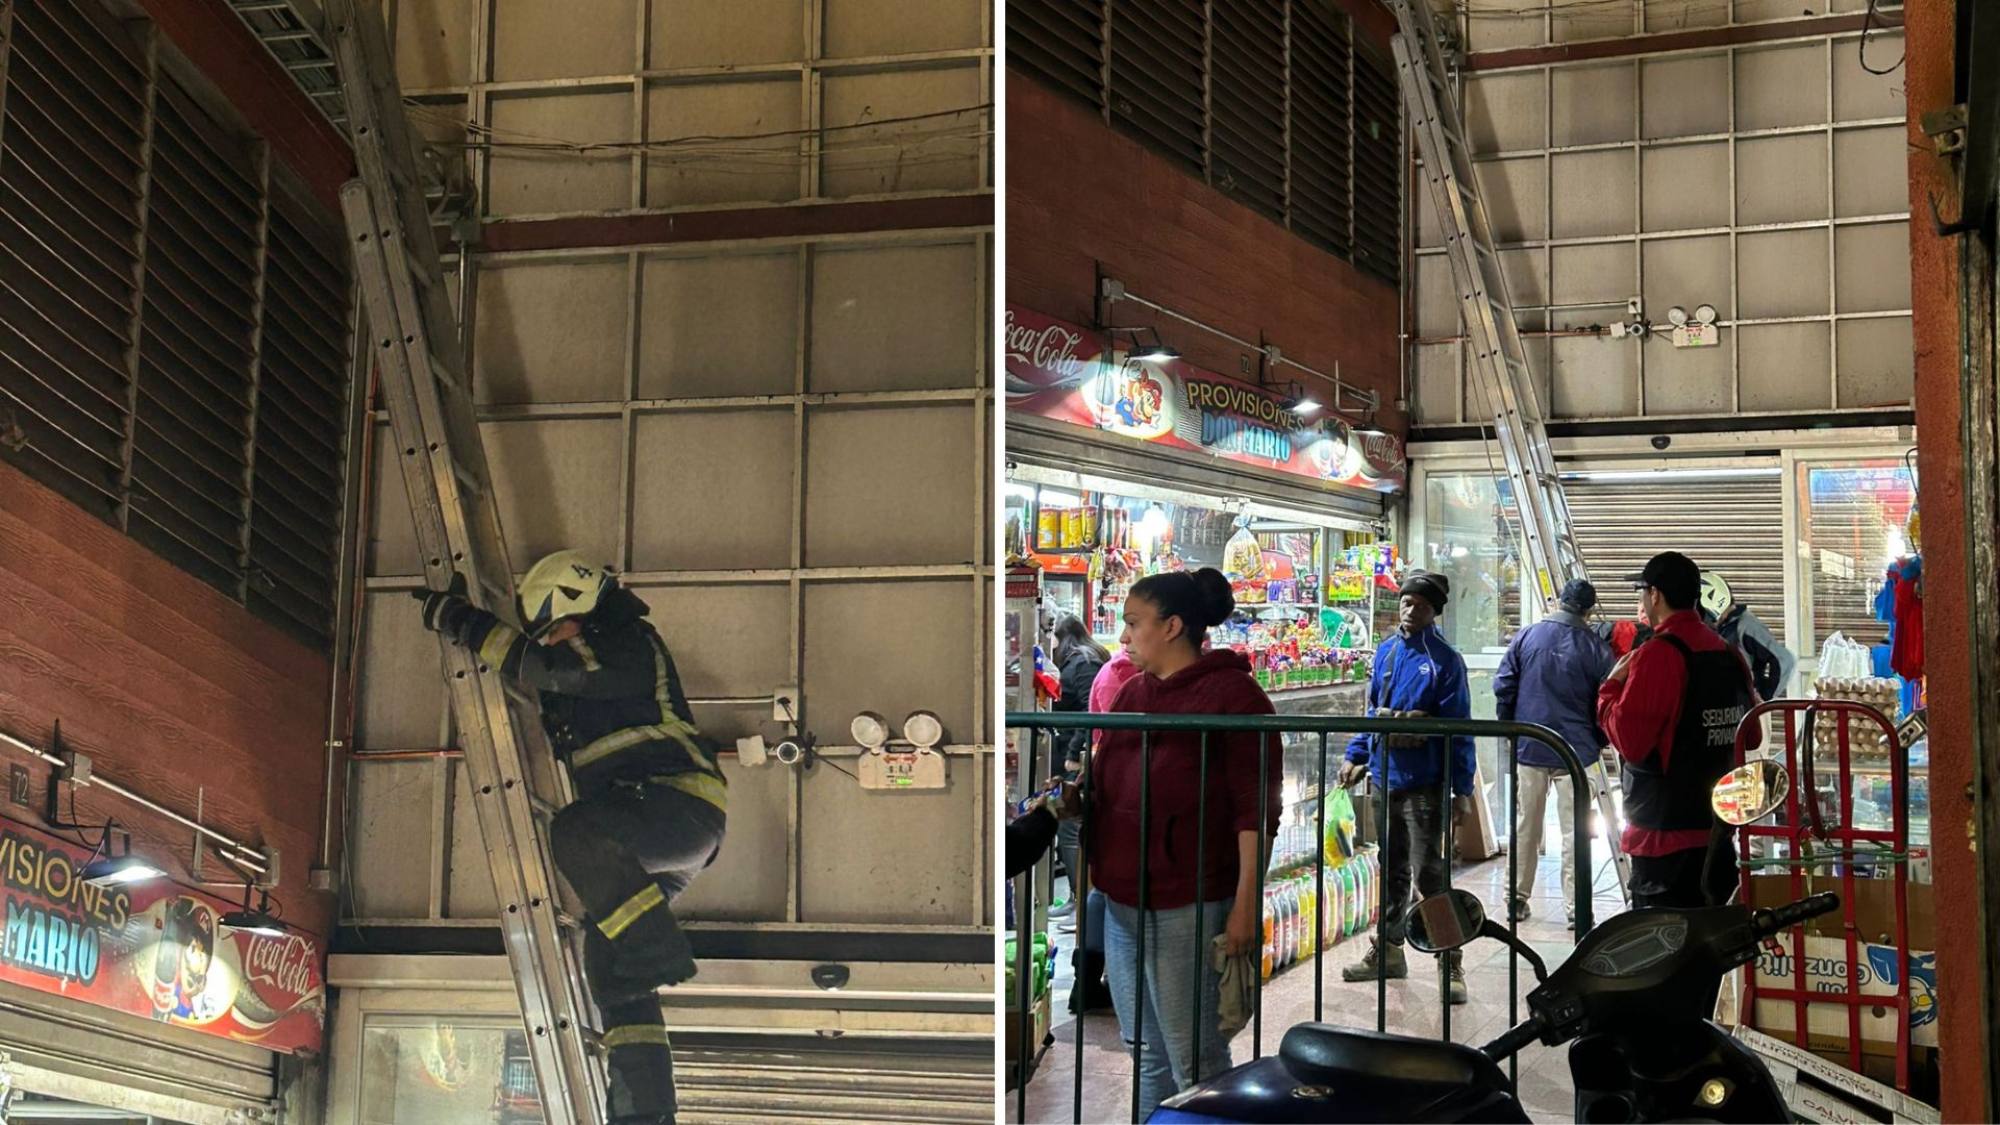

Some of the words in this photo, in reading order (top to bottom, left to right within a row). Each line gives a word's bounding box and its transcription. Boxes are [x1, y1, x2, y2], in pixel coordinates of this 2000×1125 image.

[1187, 382, 1305, 433] PROVISIONES
[1202, 411, 1238, 452] DON
[1243, 422, 1291, 462] MARIO
[4, 901, 99, 981] MARIO
